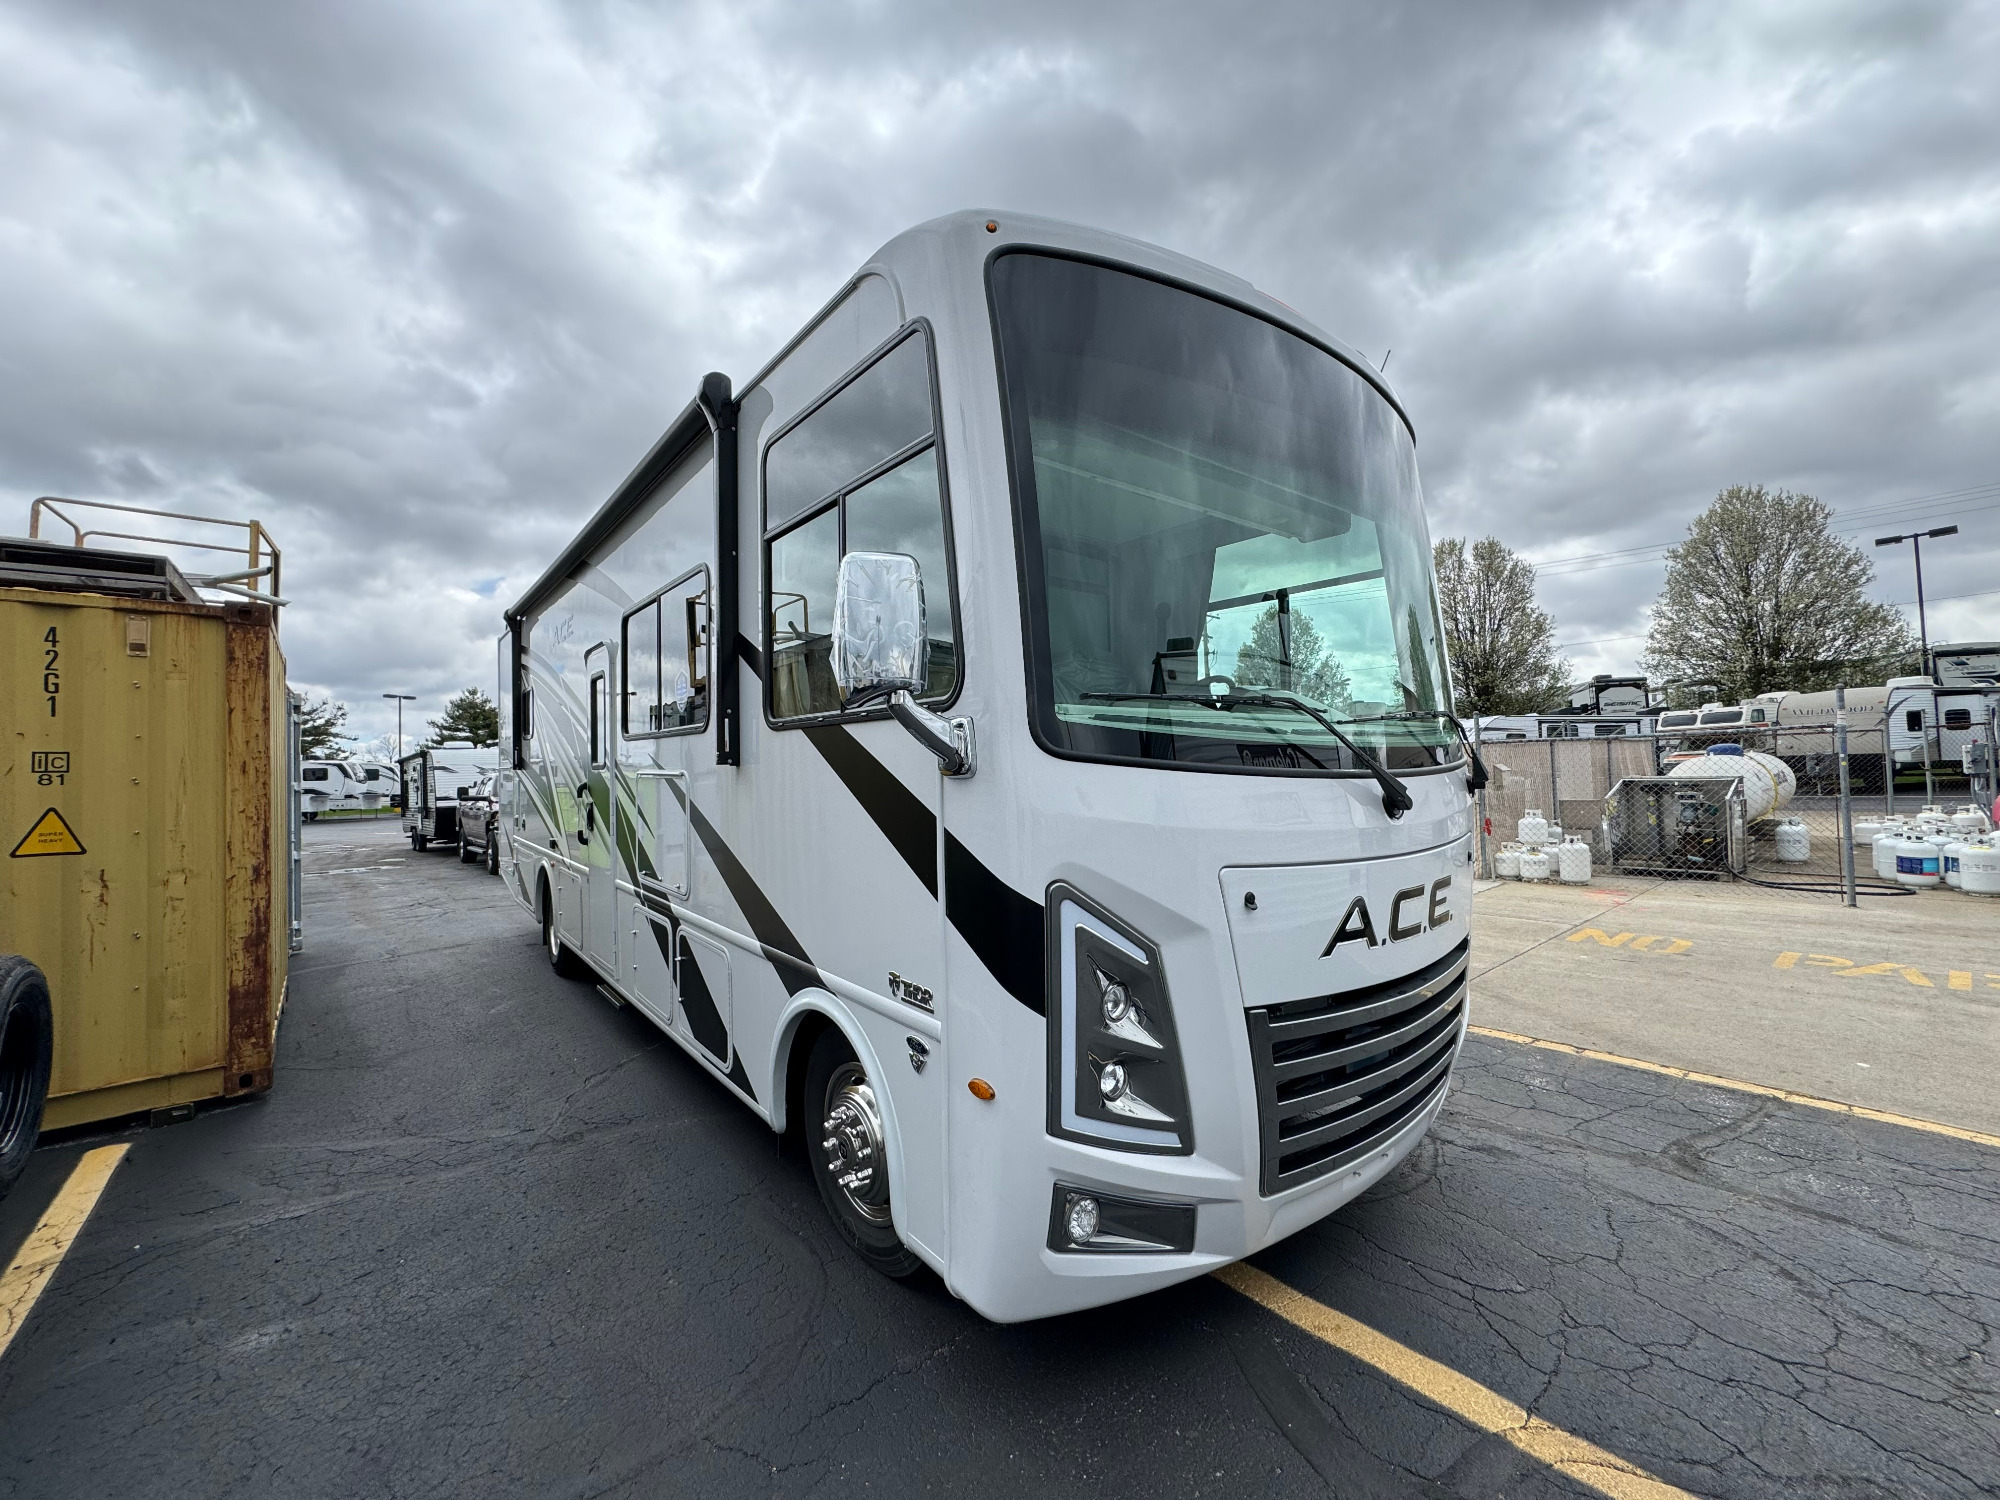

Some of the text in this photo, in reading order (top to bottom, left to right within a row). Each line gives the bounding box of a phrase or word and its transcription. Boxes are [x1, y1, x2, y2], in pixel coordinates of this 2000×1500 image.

[43, 627, 60, 717] 42G1
[1943, 664, 1996, 672] CARBON
[37, 774, 65, 785] 81
[1318, 875, 1453, 960] A.C.E.
[1565, 927, 1693, 954] NO
[900, 978, 934, 1010] THOR
